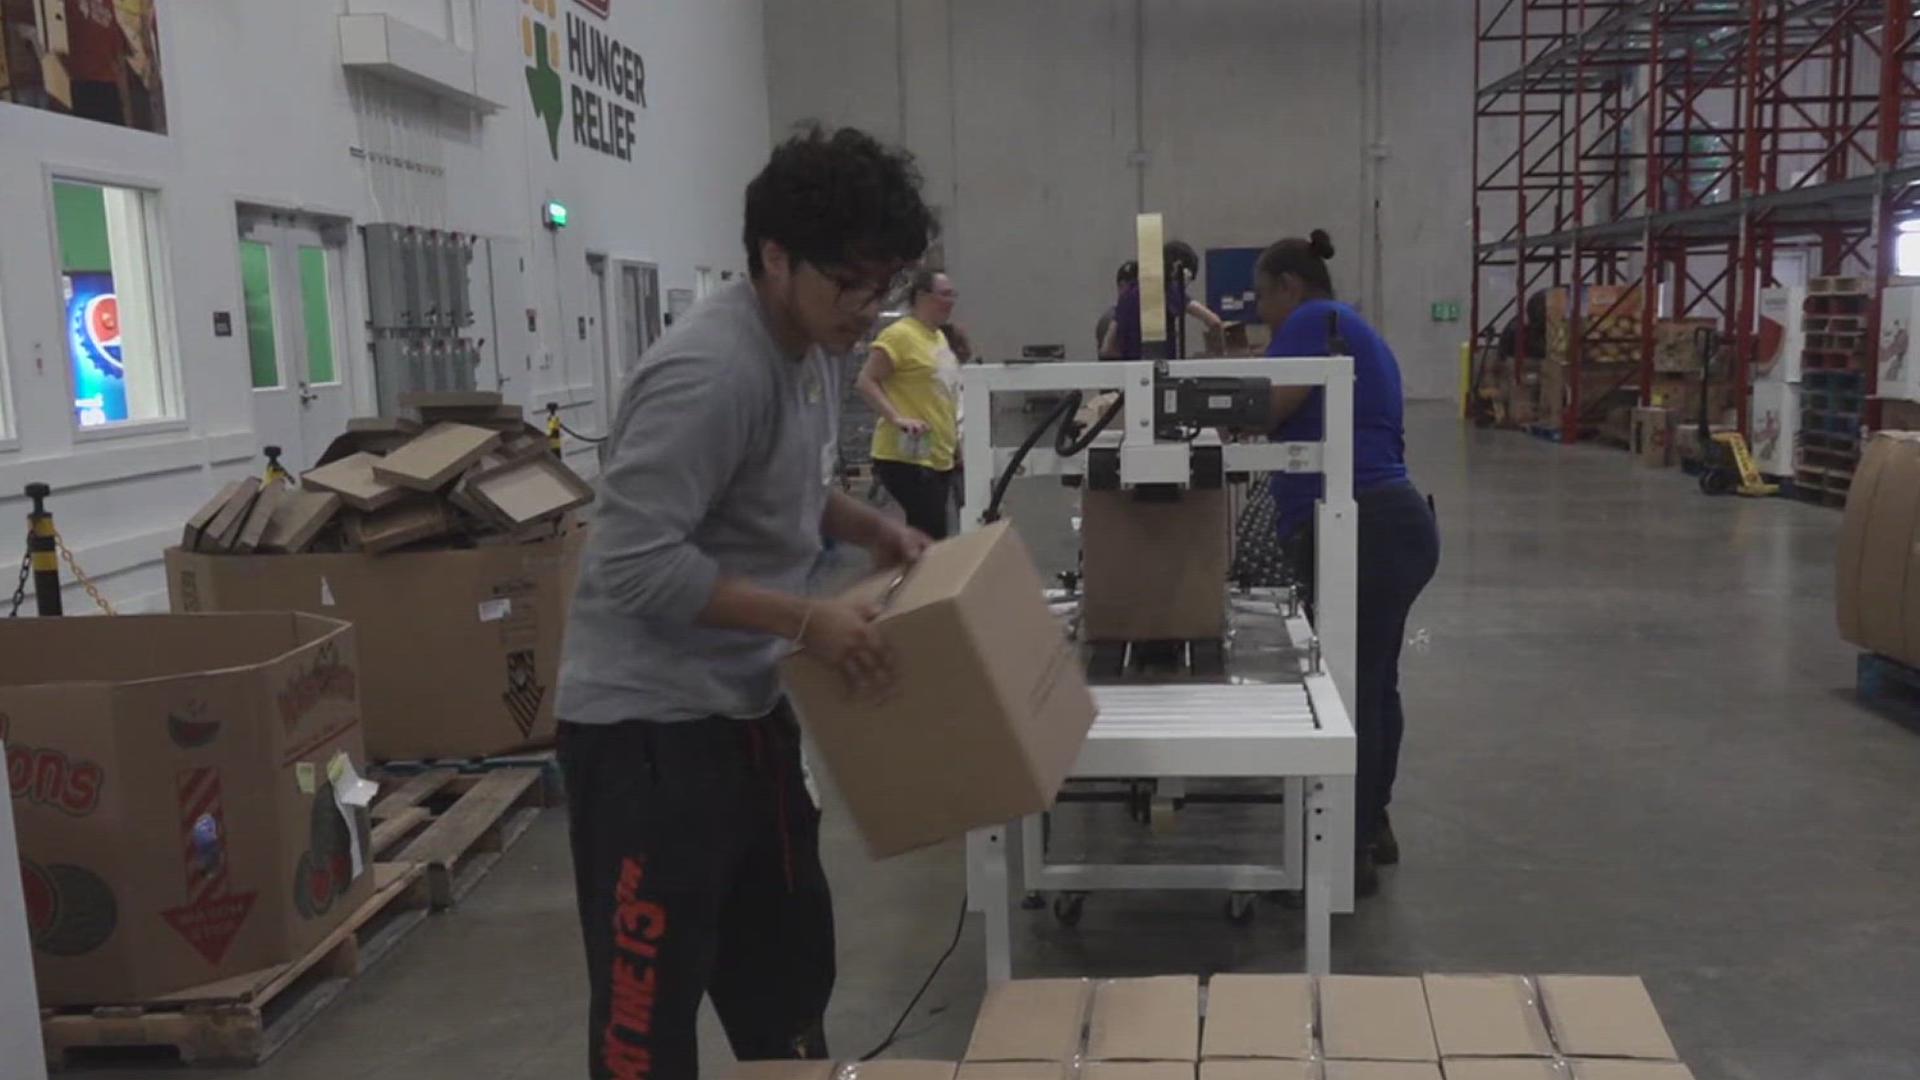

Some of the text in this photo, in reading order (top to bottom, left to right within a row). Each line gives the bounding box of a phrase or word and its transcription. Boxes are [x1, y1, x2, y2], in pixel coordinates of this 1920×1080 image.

[566, 11, 647, 108] HUNGER
[571, 84, 636, 162] RELIEF
[0, 713, 103, 817] ons
